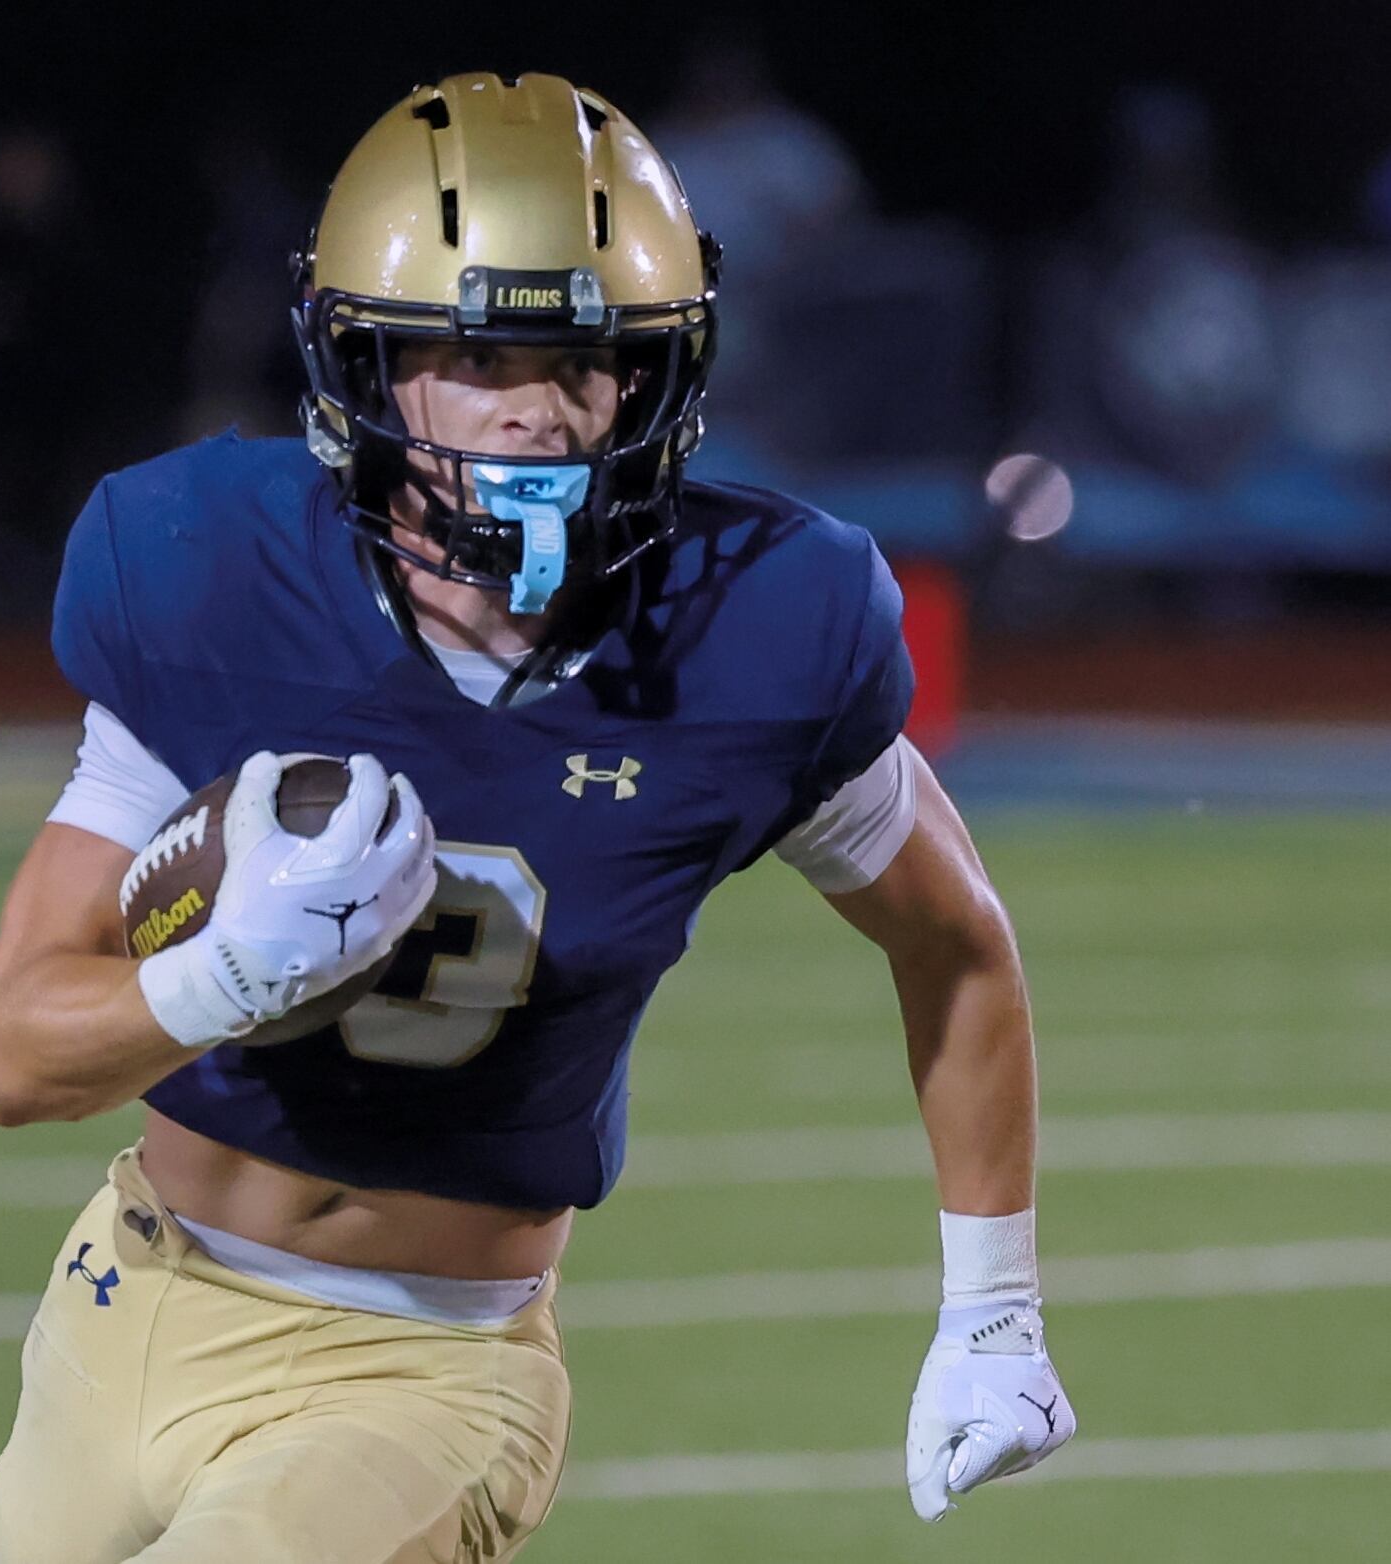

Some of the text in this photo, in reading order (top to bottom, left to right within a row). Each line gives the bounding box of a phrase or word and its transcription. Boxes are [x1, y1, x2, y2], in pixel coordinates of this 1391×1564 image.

[496, 287, 562, 308] LIONS
[132, 887, 205, 958] Wilson
[338, 840, 546, 1068] 3
